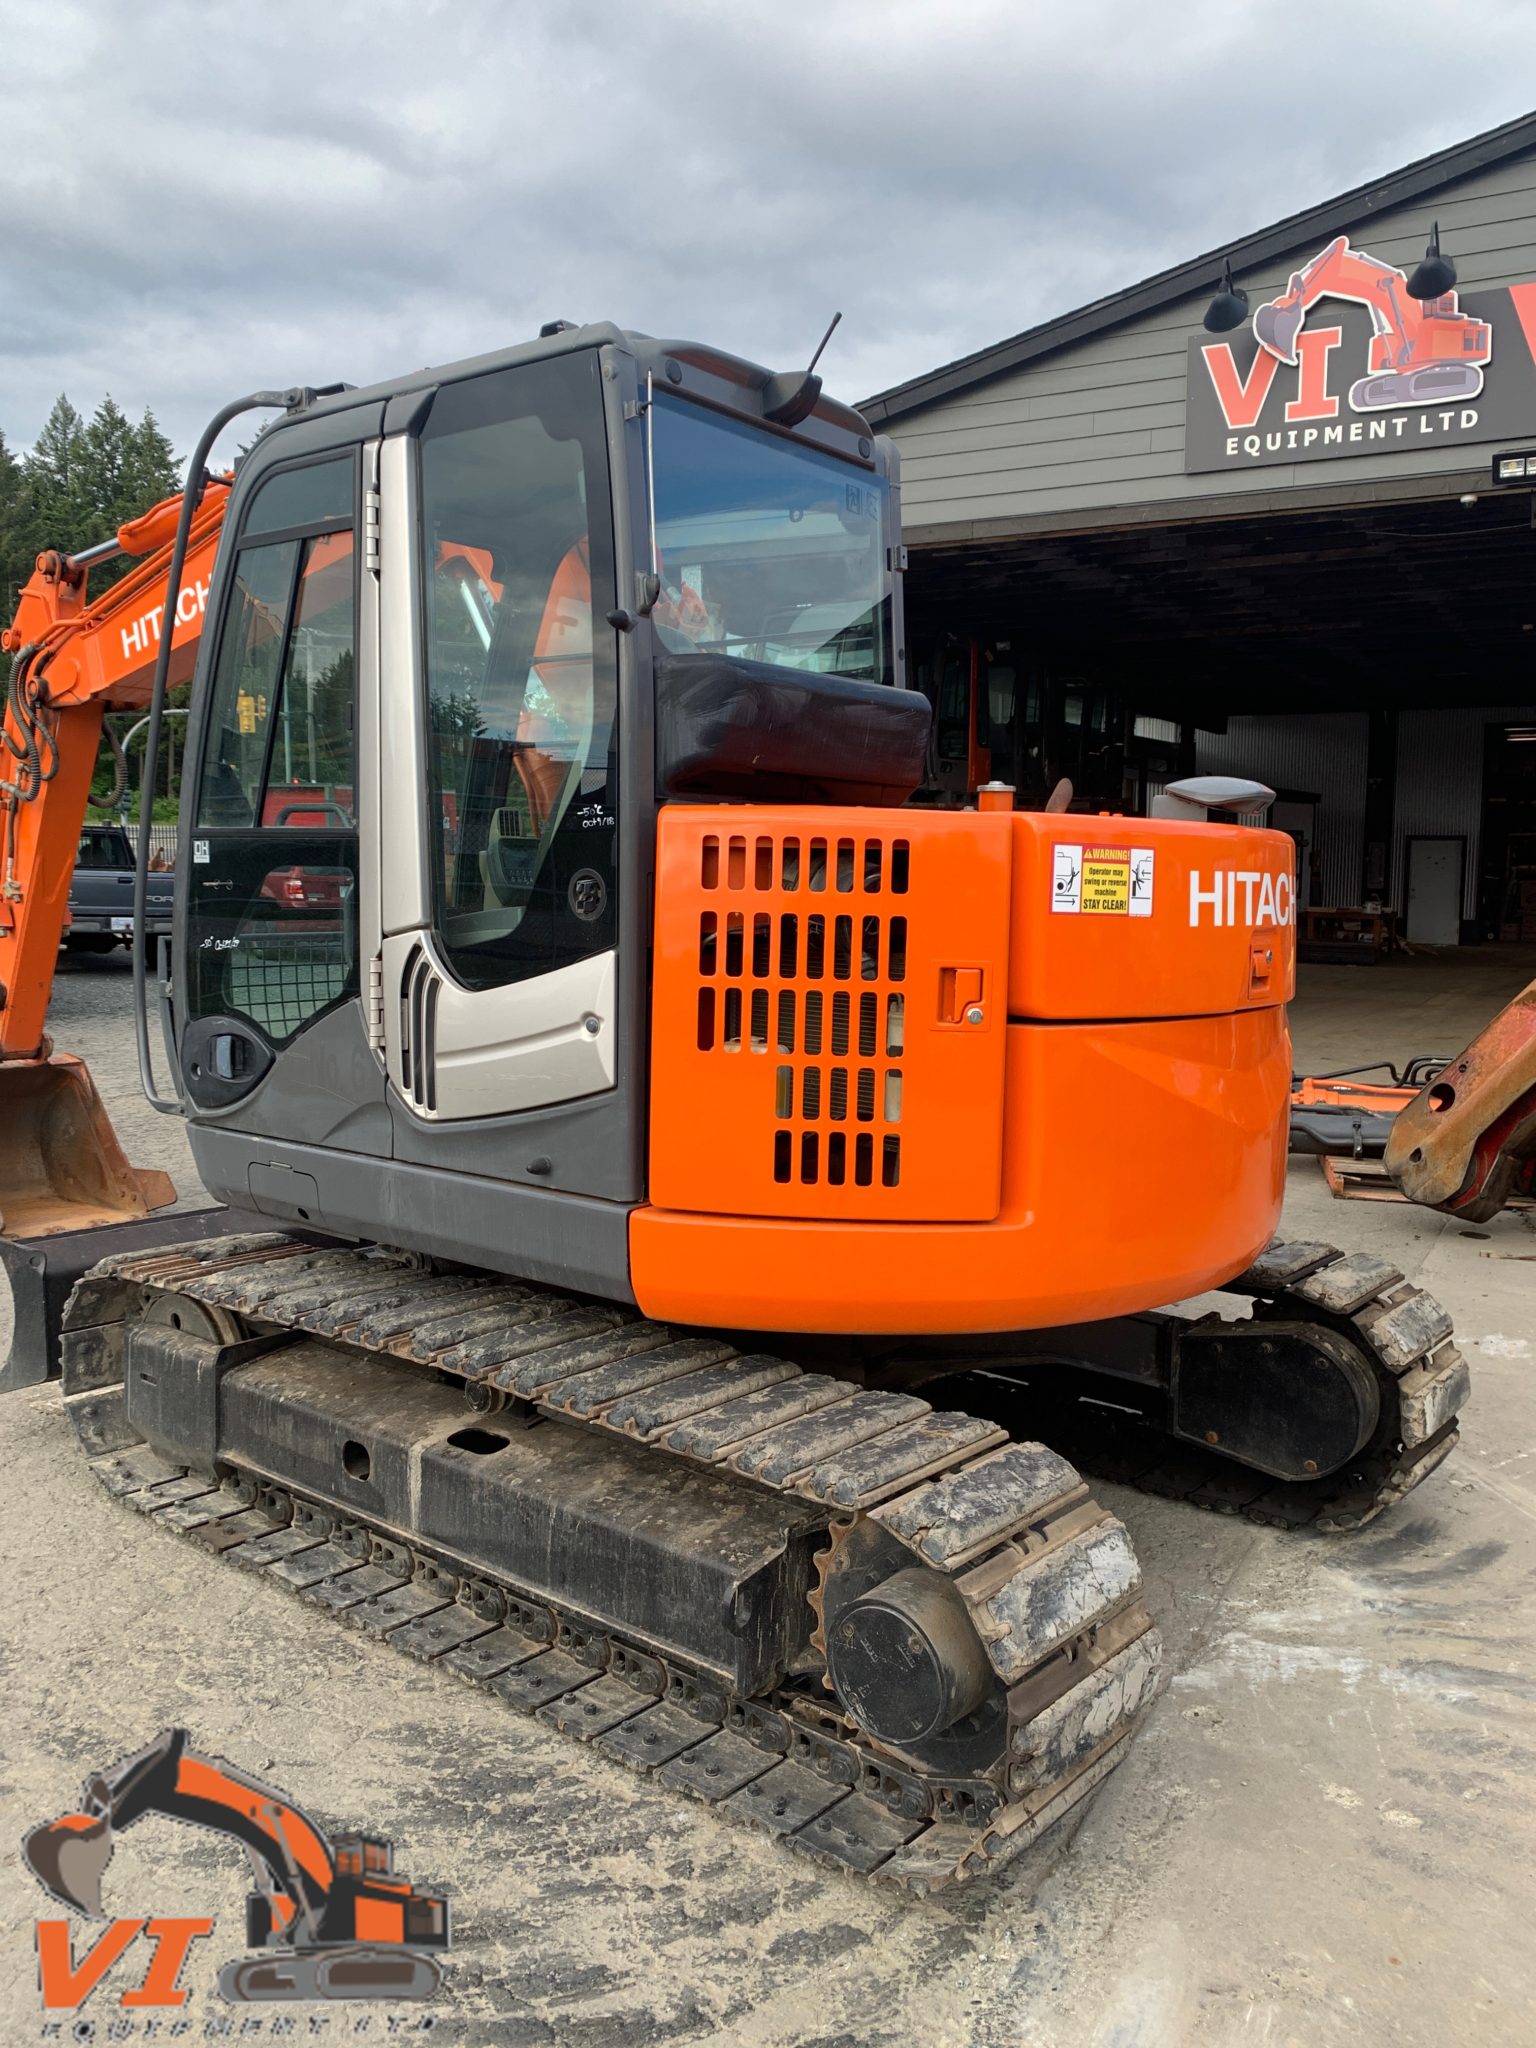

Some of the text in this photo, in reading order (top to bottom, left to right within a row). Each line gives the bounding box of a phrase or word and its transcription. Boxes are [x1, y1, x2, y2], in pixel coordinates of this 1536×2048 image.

[1201, 326, 1342, 430] VI
[1226, 409, 1479, 456] EQUIPMENT LTD
[120, 573, 212, 659] HITCH
[1092, 848, 1130, 861] WARNING!
[1089, 867, 1124, 877] Operator may
[1084, 878, 1100, 887] swing
[1094, 888, 1117, 897] machine
[1083, 898, 1127, 911] STAY CLEAR!
